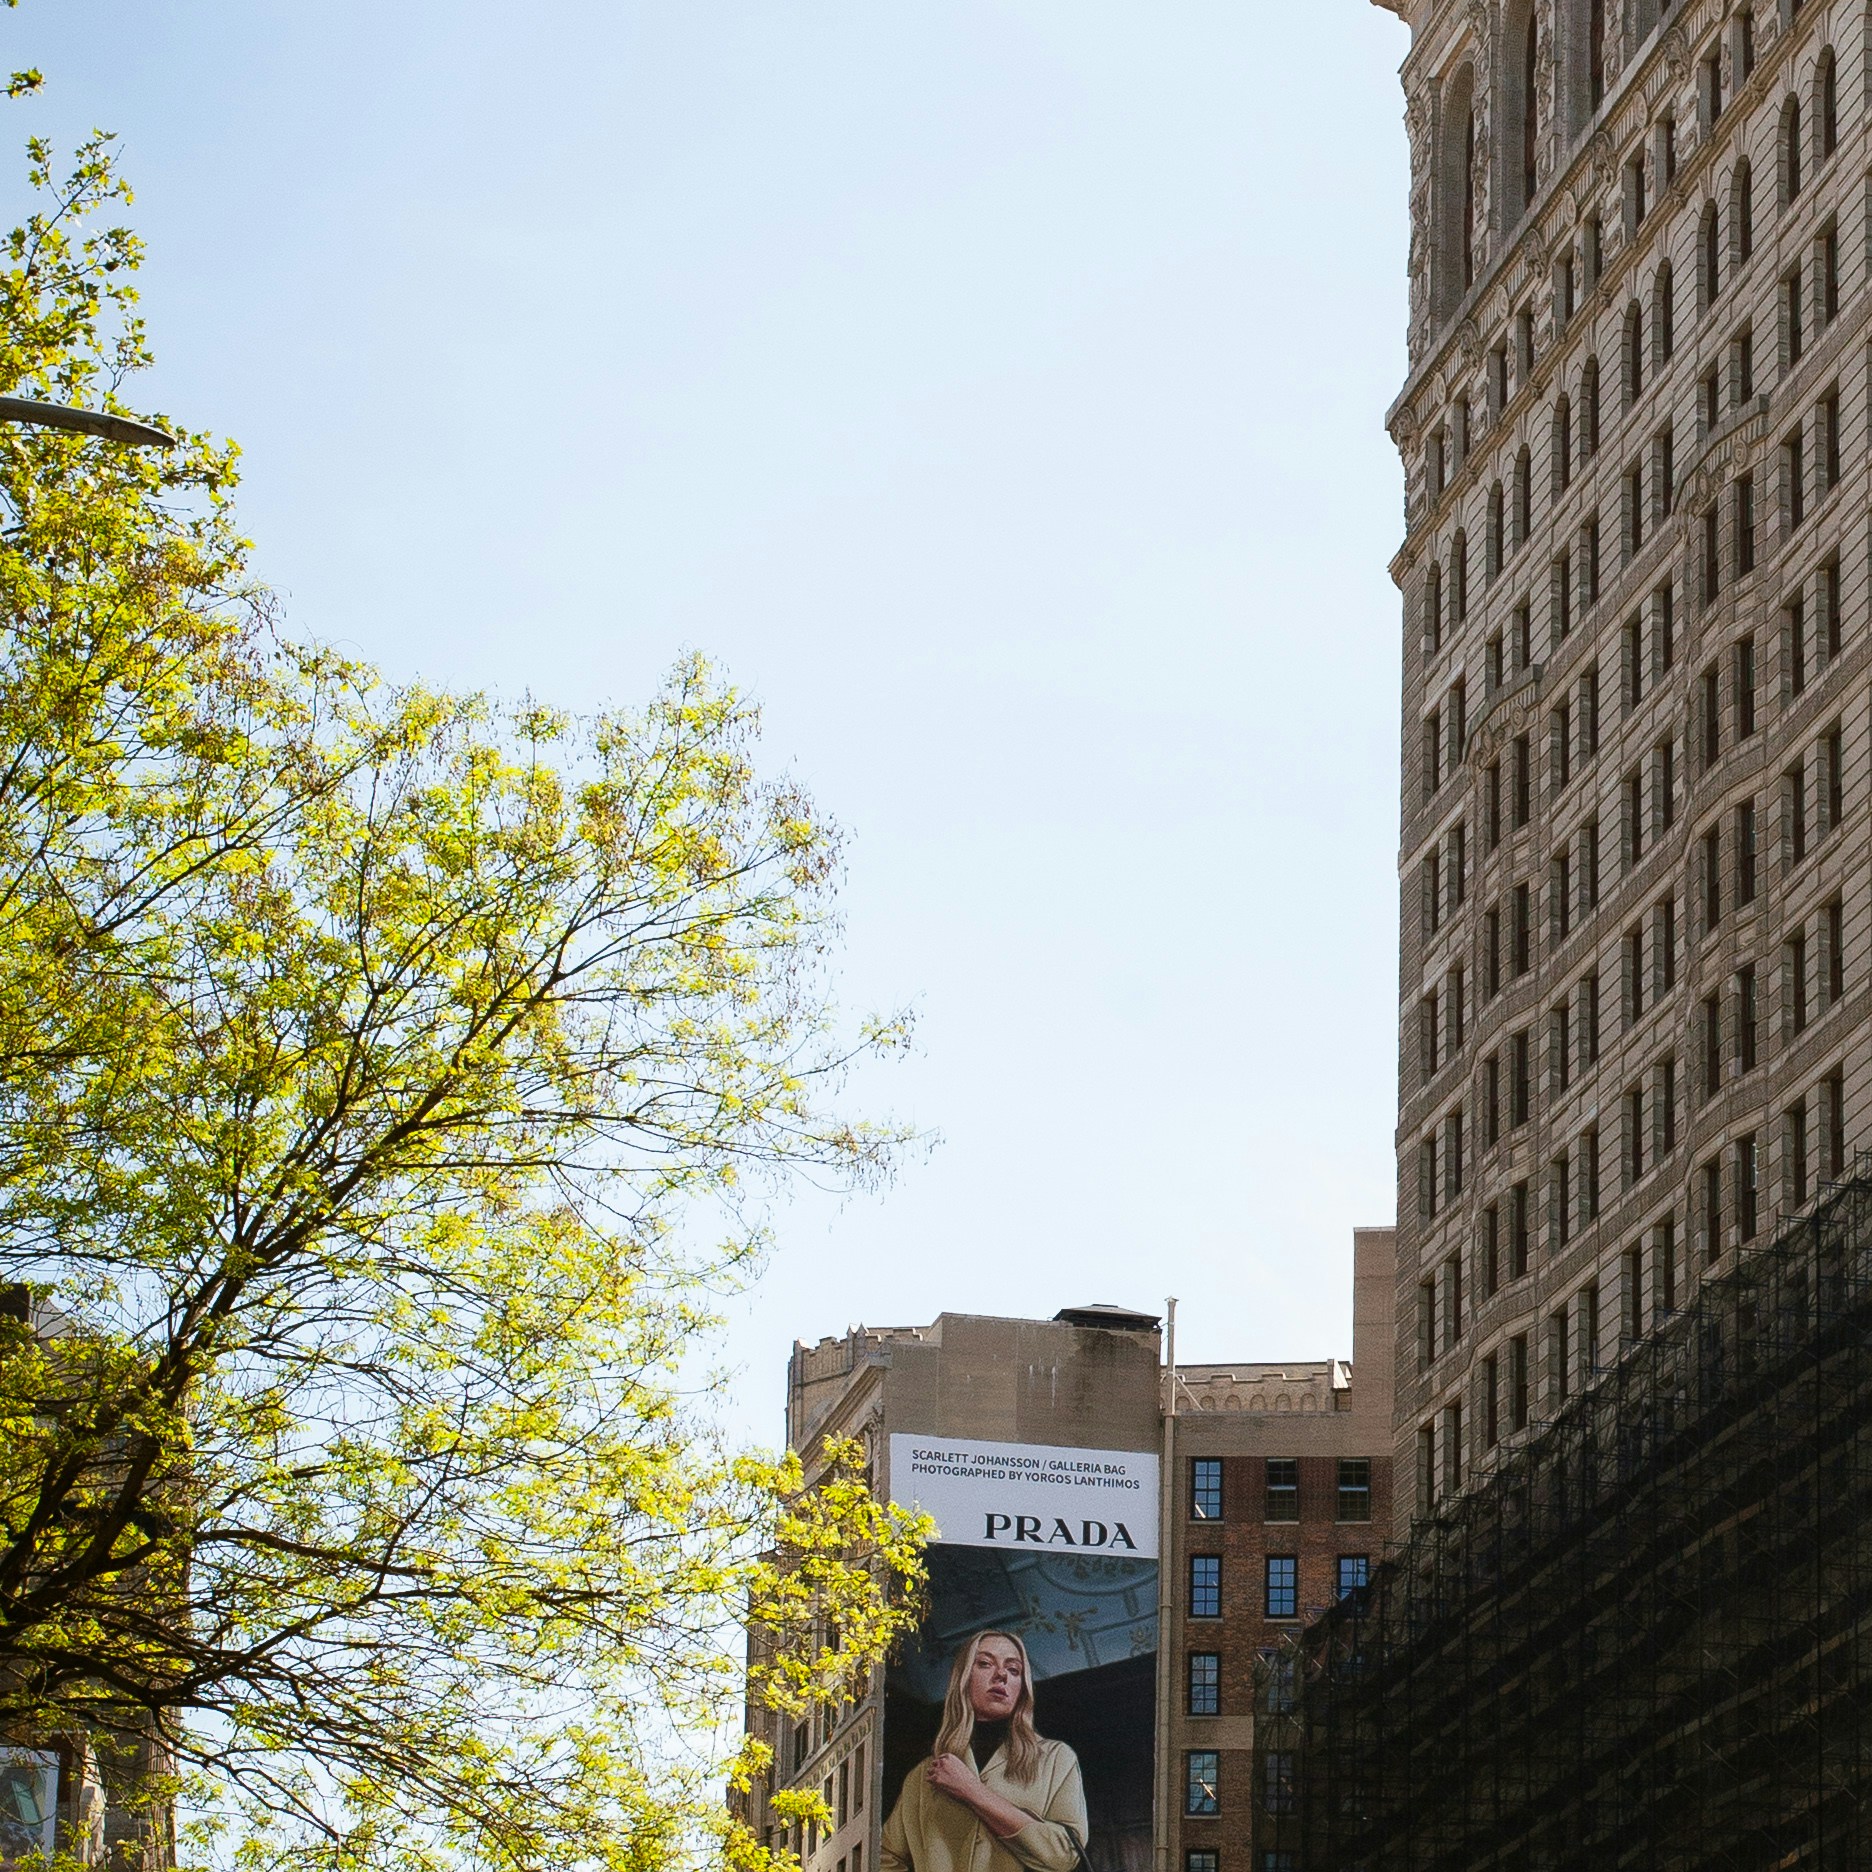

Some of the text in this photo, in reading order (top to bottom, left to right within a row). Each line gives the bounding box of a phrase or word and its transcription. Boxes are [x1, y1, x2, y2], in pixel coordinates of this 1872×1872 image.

[912, 1449, 969, 1464] SCARLETT
[971, 1454, 1040, 1469] JOHANSSON
[1049, 1460, 1101, 1474] GALLERIA
[1104, 1464, 1126, 1476] BAG
[911, 1463, 1140, 1490] PHOTOGRAPHED BY YORGOS LANTHIMOS
[983, 1512, 1138, 1551] PRADA
